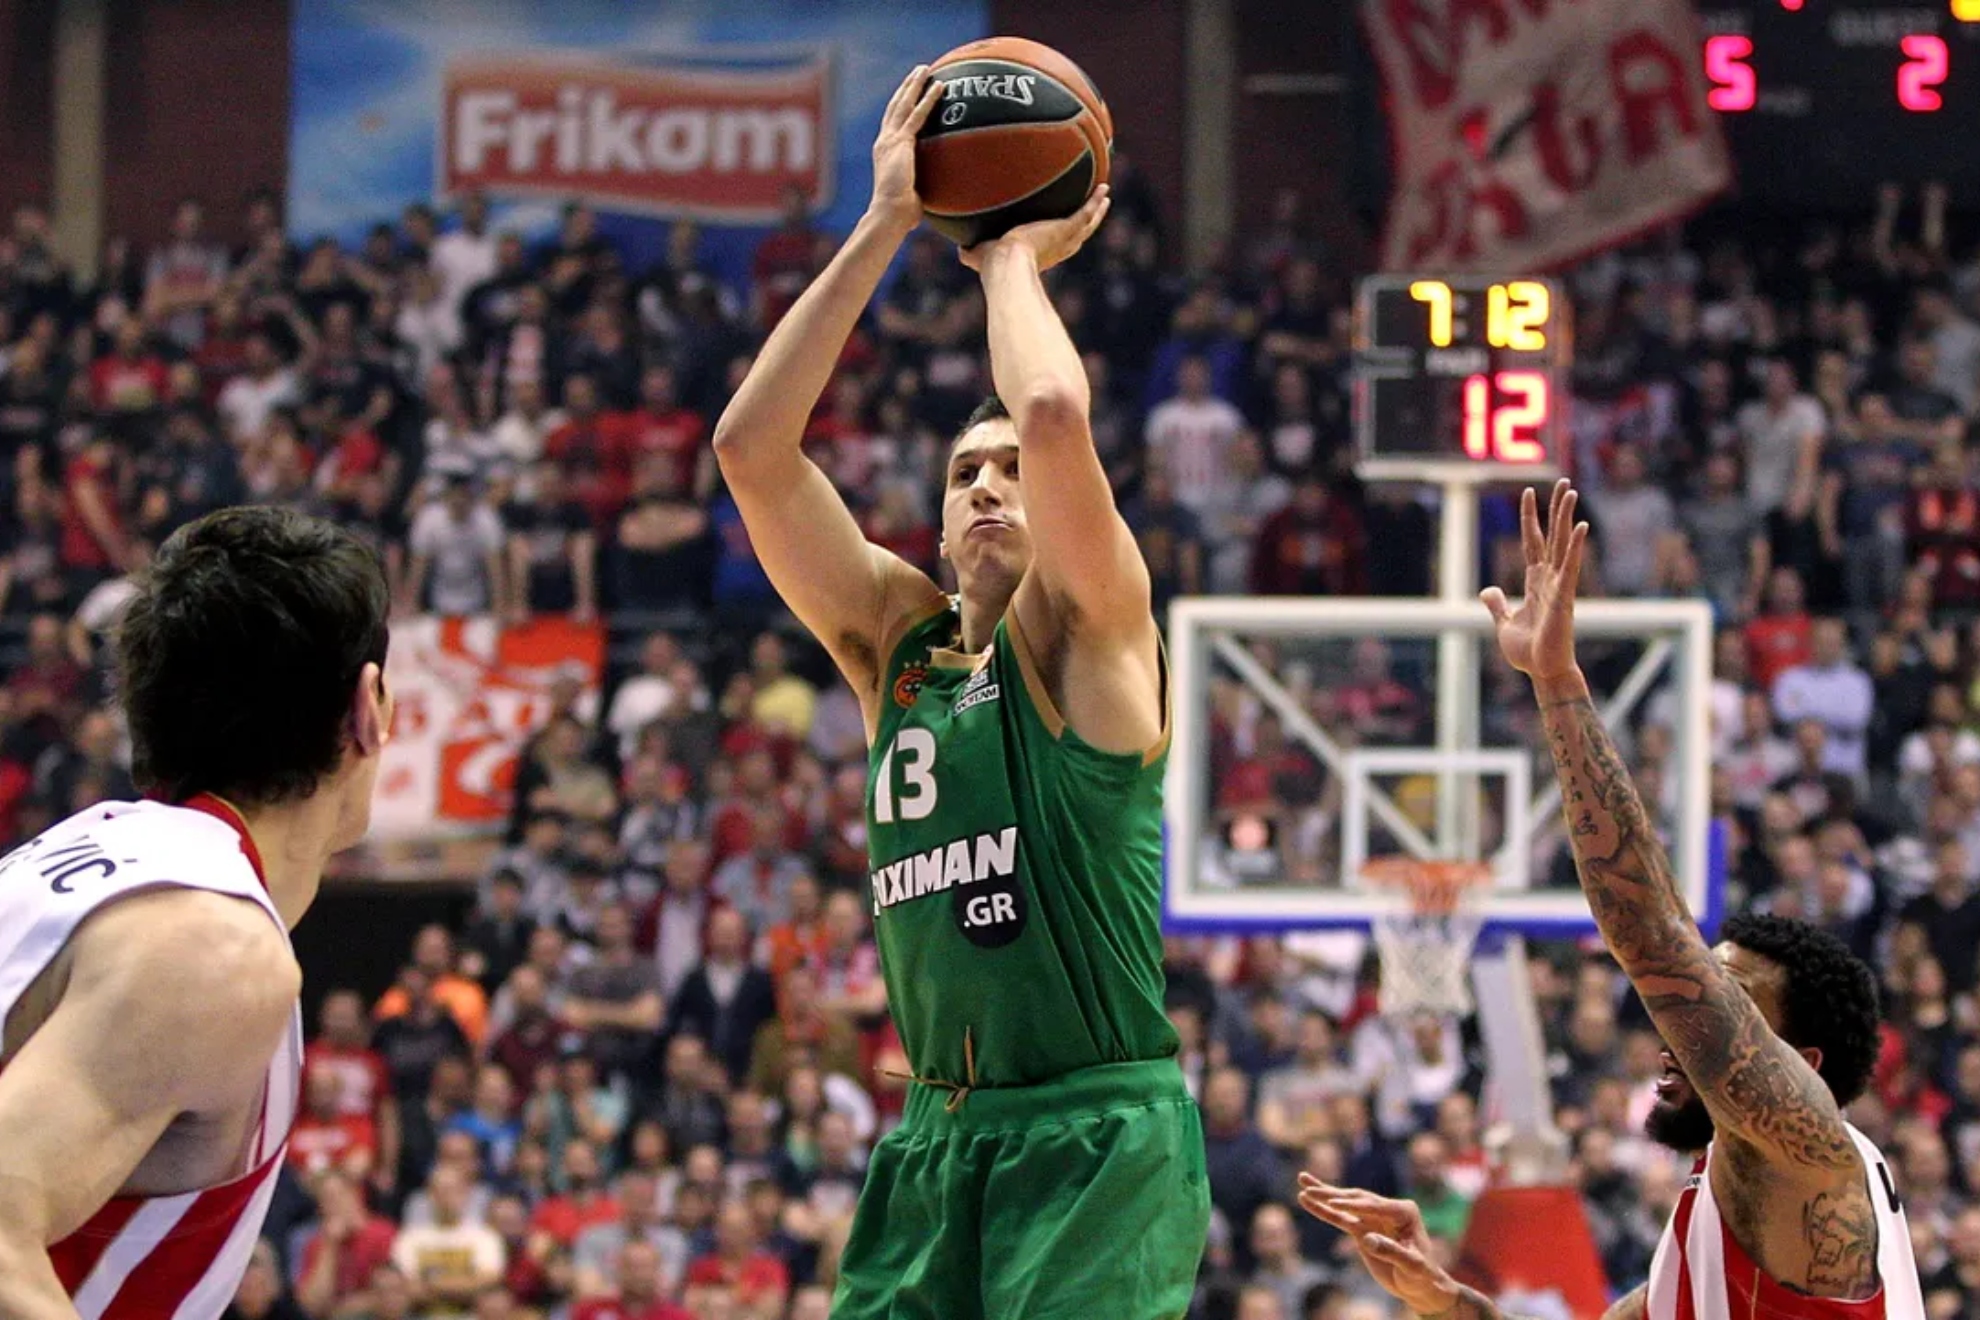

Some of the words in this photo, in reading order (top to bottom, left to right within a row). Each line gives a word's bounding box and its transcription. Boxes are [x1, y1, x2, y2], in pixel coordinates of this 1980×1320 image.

[1705, 35, 1755, 111] 5
[1897, 35, 1948, 111] 2
[455, 90, 814, 173] Frikom
[1464, 372, 1547, 461] 12
[875, 728, 937, 823] 13
[872, 826, 1017, 908] IXIMAN
